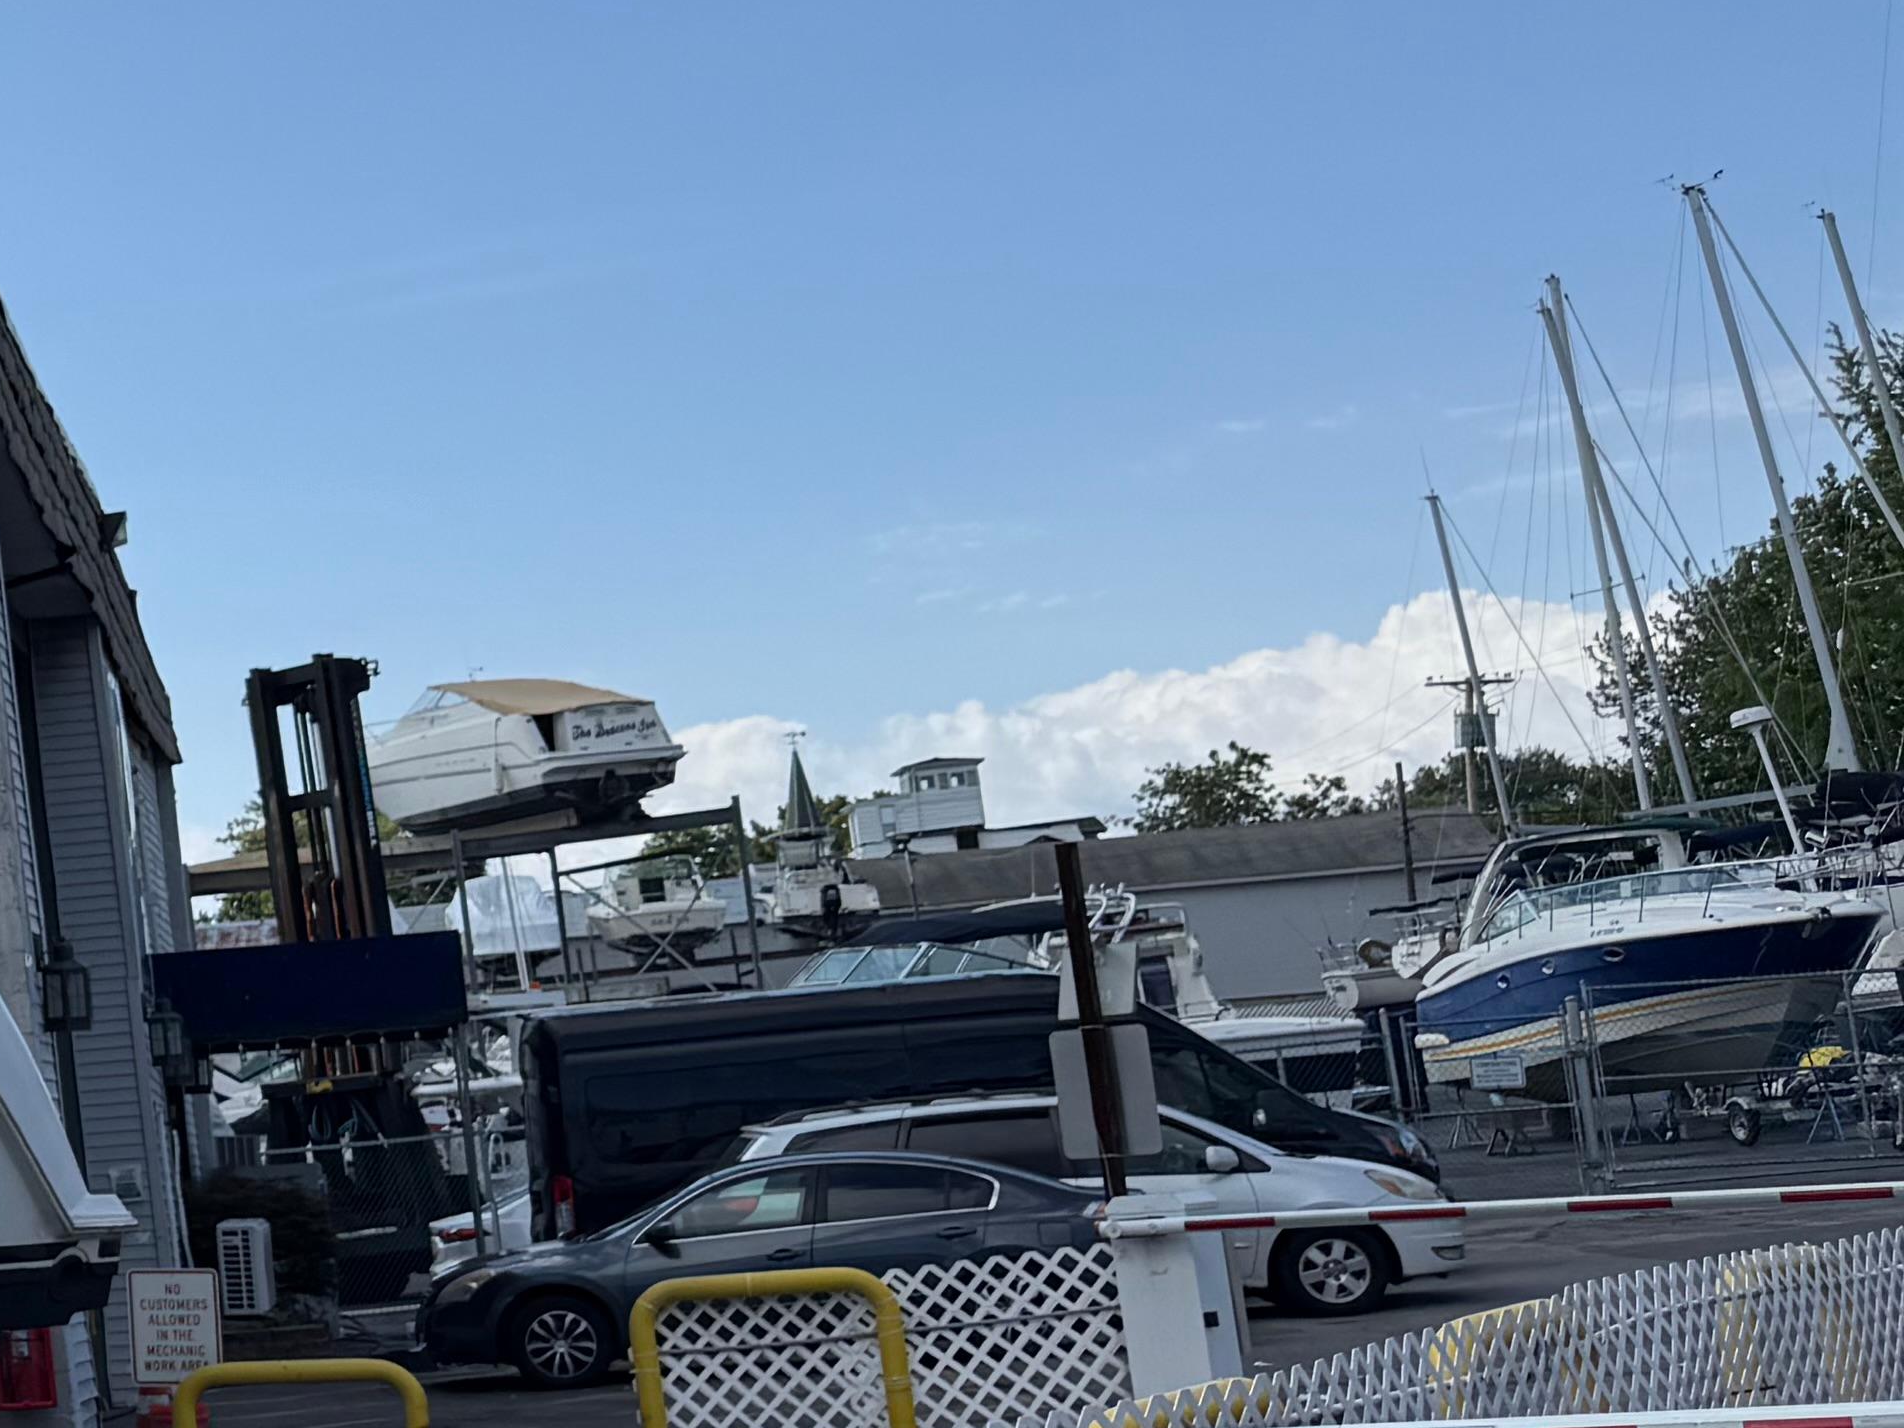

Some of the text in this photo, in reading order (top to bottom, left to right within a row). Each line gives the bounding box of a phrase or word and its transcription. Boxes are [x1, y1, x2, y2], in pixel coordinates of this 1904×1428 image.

[165, 1283, 181, 1295] NO
[139, 1298, 209, 1311] CUSTOMERS
[148, 1314, 201, 1326] ALLOWED
[156, 1329, 194, 1341] IN THE
[146, 1345, 206, 1357] MECHANIC
[144, 1360, 177, 1371] WORK
